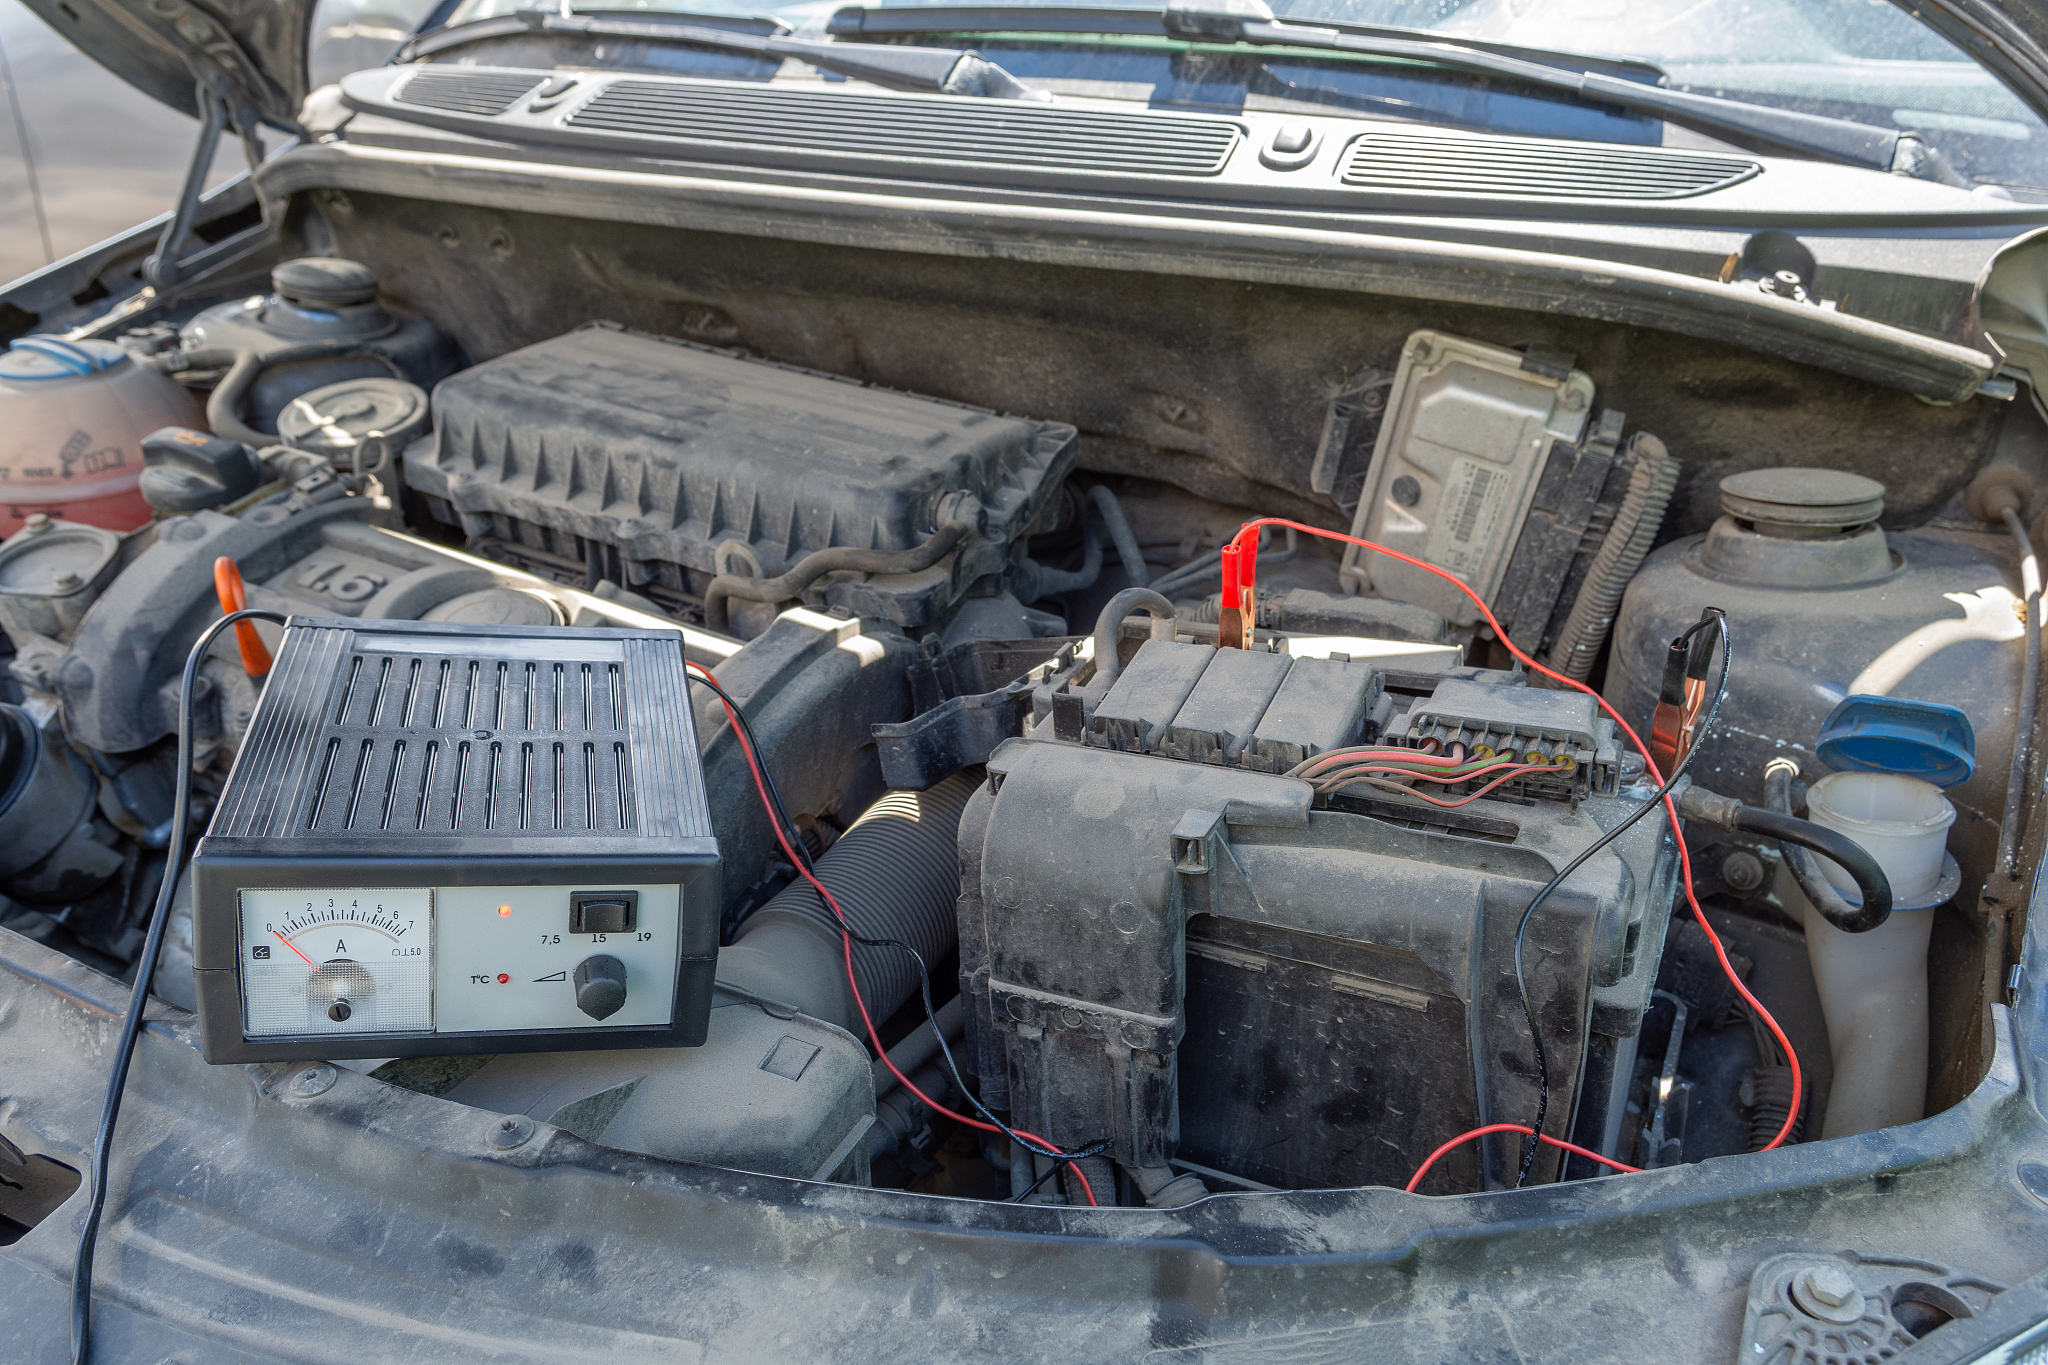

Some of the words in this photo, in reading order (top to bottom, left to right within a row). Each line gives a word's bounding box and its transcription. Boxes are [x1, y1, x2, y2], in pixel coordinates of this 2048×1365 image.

[298, 562, 388, 603] 1.6
[266, 923, 272, 933] 0
[285, 911, 290, 920] 1
[306, 902, 312, 911] 2
[328, 898, 334, 907] 3
[352, 899, 358, 908] 4
[377, 904, 383, 913] 5
[393, 910, 399, 920] 6
[409, 921, 414, 929] 7
[335, 939, 347, 953] A
[541, 934, 561, 945] 7,5
[591, 933, 607, 943] 15
[637, 932, 652, 942] 19
